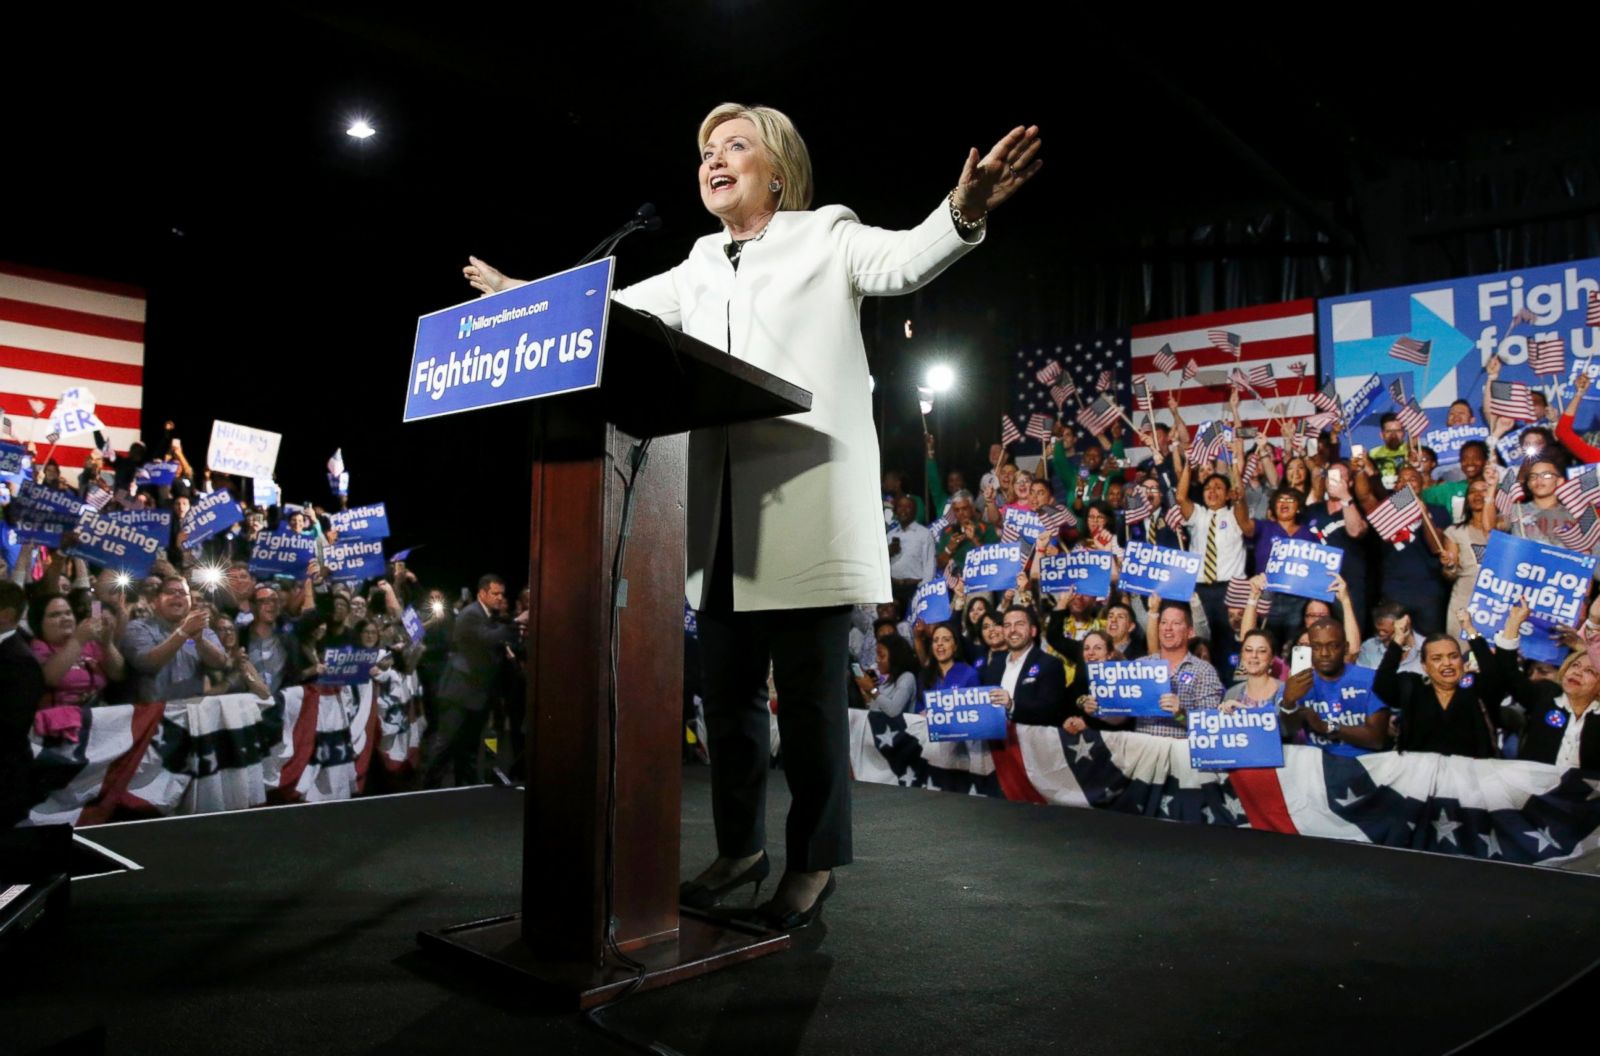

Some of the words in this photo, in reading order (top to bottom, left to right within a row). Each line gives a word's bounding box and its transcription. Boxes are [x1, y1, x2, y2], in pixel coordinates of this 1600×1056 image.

[471, 300, 549, 331] hillaryclinton.com
[413, 346, 511, 401] Fighting
[514, 333, 556, 374] for
[558, 328, 595, 364] us
[1427, 425, 1489, 443] Fighting
[197, 511, 217, 526] us
[331, 505, 385, 525] Fighting
[351, 519, 369, 530] us
[79, 510, 159, 553] Fighting
[102, 540, 126, 556] us
[256, 530, 318, 554] Fighting
[322, 541, 383, 561] Fighting
[252, 545, 277, 560] for
[278, 551, 297, 563] us
[346, 557, 365, 569] us
[965, 544, 1021, 566] Fighting
[1040, 552, 1111, 570] Fighting
[1125, 540, 1200, 574] Fighting
[1270, 538, 1342, 571] Fighting
[963, 564, 979, 579] for
[980, 563, 998, 576] us
[1040, 568, 1067, 581] for
[1068, 567, 1088, 579] us
[1121, 557, 1147, 576] for
[1148, 568, 1170, 582] us
[1284, 562, 1310, 578] us
[1516, 562, 1546, 583] us
[1477, 568, 1581, 619] Fighting
[1547, 571, 1588, 597] for
[1467, 604, 1502, 627] for
[324, 648, 378, 664] Fighting
[343, 663, 359, 675] us
[1088, 660, 1168, 685] Fighting
[1089, 682, 1116, 699] for
[1118, 683, 1142, 698] us
[927, 707, 954, 726] for
[957, 709, 979, 723] us
[1189, 711, 1276, 734] Fighting
[1188, 730, 1219, 749] for
[1222, 732, 1249, 748] us
